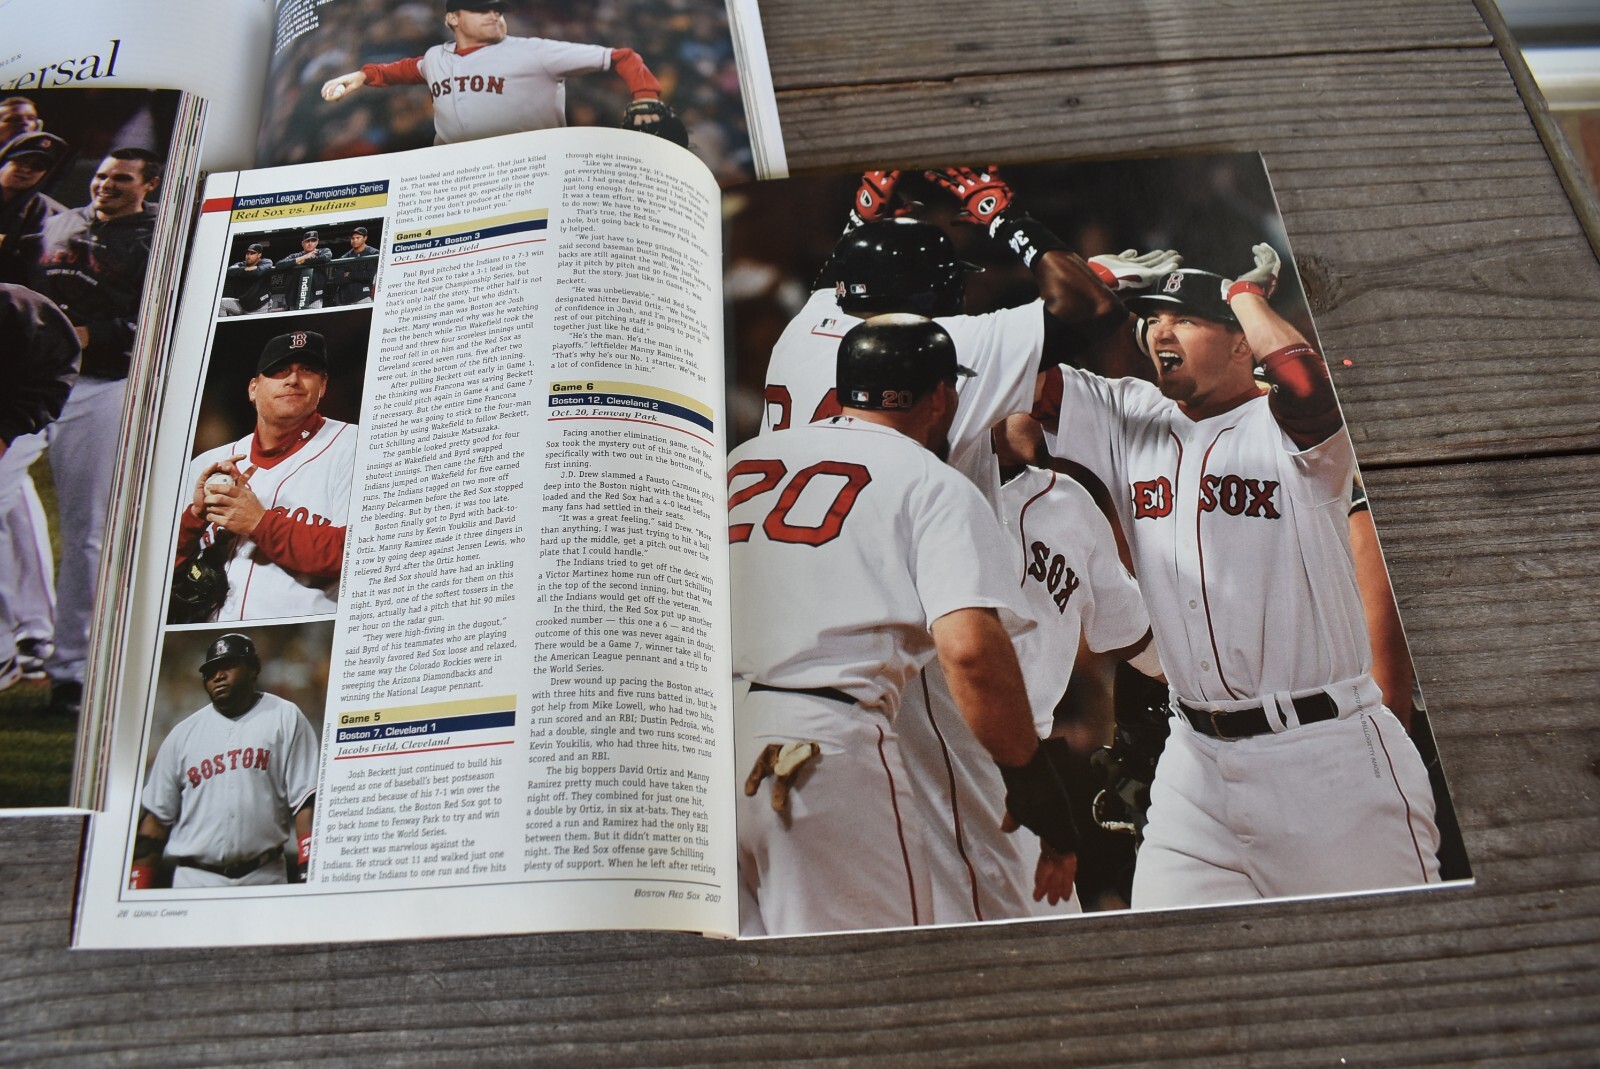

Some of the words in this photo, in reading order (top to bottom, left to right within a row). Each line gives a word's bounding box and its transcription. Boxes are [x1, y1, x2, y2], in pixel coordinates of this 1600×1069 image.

[432, 75, 505, 98] OSTON
[419, 171, 441, 180] loaded
[442, 169, 455, 177] and
[456, 166, 481, 175] nobody
[497, 160, 511, 168] that
[512, 158, 526, 166] just
[527, 154, 547, 163] killed
[238, 194, 274, 207] American
[276, 192, 303, 204] League
[305, 186, 357, 200] Championship
[360, 182, 384, 192] Series
[235, 208, 258, 220] Red
[262, 208, 284, 217] Sox
[310, 200, 356, 212] Indians
[394, 241, 432, 252] Cleveland
[445, 235, 472, 244] Boston
[396, 232, 422, 240] Game
[428, 248, 456, 258] Jacobs
[458, 243, 479, 252] Field
[403, 270, 417, 279] Paul
[419, 267, 435, 277] Byrd
[436, 263, 461, 275] pitched
[463, 261, 475, 269] the
[476, 257, 501, 266] Indians
[1163, 272, 1184, 292] B
[555, 294, 596, 304] designated
[597, 295, 619, 303] hitter
[621, 297, 642, 306] David
[289, 331, 308, 349] B
[378, 361, 410, 372] Cleveland
[411, 357, 434, 367] scored
[435, 355, 454, 363] seven
[475, 348, 489, 356] five
[490, 345, 508, 353] after
[552, 383, 582, 391] Game
[552, 396, 584, 405] Boston
[606, 397, 650, 408] Cleveland
[882, 390, 912, 407] 20
[552, 408, 572, 417] Oct.
[592, 409, 632, 419] Fenway
[635, 412, 657, 421] Park
[369, 442, 384, 450] Curt
[385, 438, 416, 448] Schilling
[417, 434, 431, 443] and
[432, 430, 460, 441] Daisuke
[461, 423, 500, 436] Matsuzaka.
[560, 470, 576, 479] J.D.
[578, 470, 599, 478] Drew
[600, 470, 636, 480] slammed
[645, 474, 670, 486] Fausto
[728, 459, 872, 548] 20
[1132, 476, 1174, 520] ED
[1200, 474, 1281, 520] SOX
[545, 570, 570, 579] Victor
[572, 569, 609, 578] Martinez
[611, 569, 634, 579] home
[653, 573, 665, 582] off
[666, 575, 683, 586] Curt
[1028, 540, 1080, 615] SOX
[340, 693, 370, 702] winning
[372, 690, 385, 699] the
[386, 686, 418, 698] National
[420, 685, 447, 695] League
[448, 680, 484, 693] pennant.
[1352, 685, 1360, 704] PHOTO
[341, 714, 370, 724] Game
[374, 712, 381, 721] 5
[531, 703, 545, 714] got
[547, 701, 567, 713] help
[569, 700, 589, 710] from
[592, 700, 613, 710] Mike
[615, 701, 646, 711] Lowell,
[649, 703, 666, 713] who
[668, 704, 683, 715] had
[685, 708, 699, 718] two
[339, 730, 370, 741] Boston
[374, 729, 382, 738] 7,
[385, 725, 428, 737] Cleveland
[431, 723, 437, 731] 1
[337, 745, 369, 757] Jacobs
[372, 742, 398, 752] Field,
[401, 737, 451, 749] Cleveland
[186, 747, 271, 788] BOSTON
[328, 807, 364, 818] Cleveland
[399, 803, 412, 812] the
[414, 802, 441, 812] Boston
[444, 799, 459, 809] Red
[461, 799, 475, 808] Sox
[478, 798, 491, 809] got
[494, 797, 502, 805] to
[526, 819, 553, 830] scored
[564, 820, 580, 828] run
[582, 817, 599, 827] and
[602, 817, 639, 827] Ramirez
[641, 817, 658, 828] had
[660, 819, 675, 829] the
[677, 821, 695, 833] only
[696, 823, 709, 833] RBI
